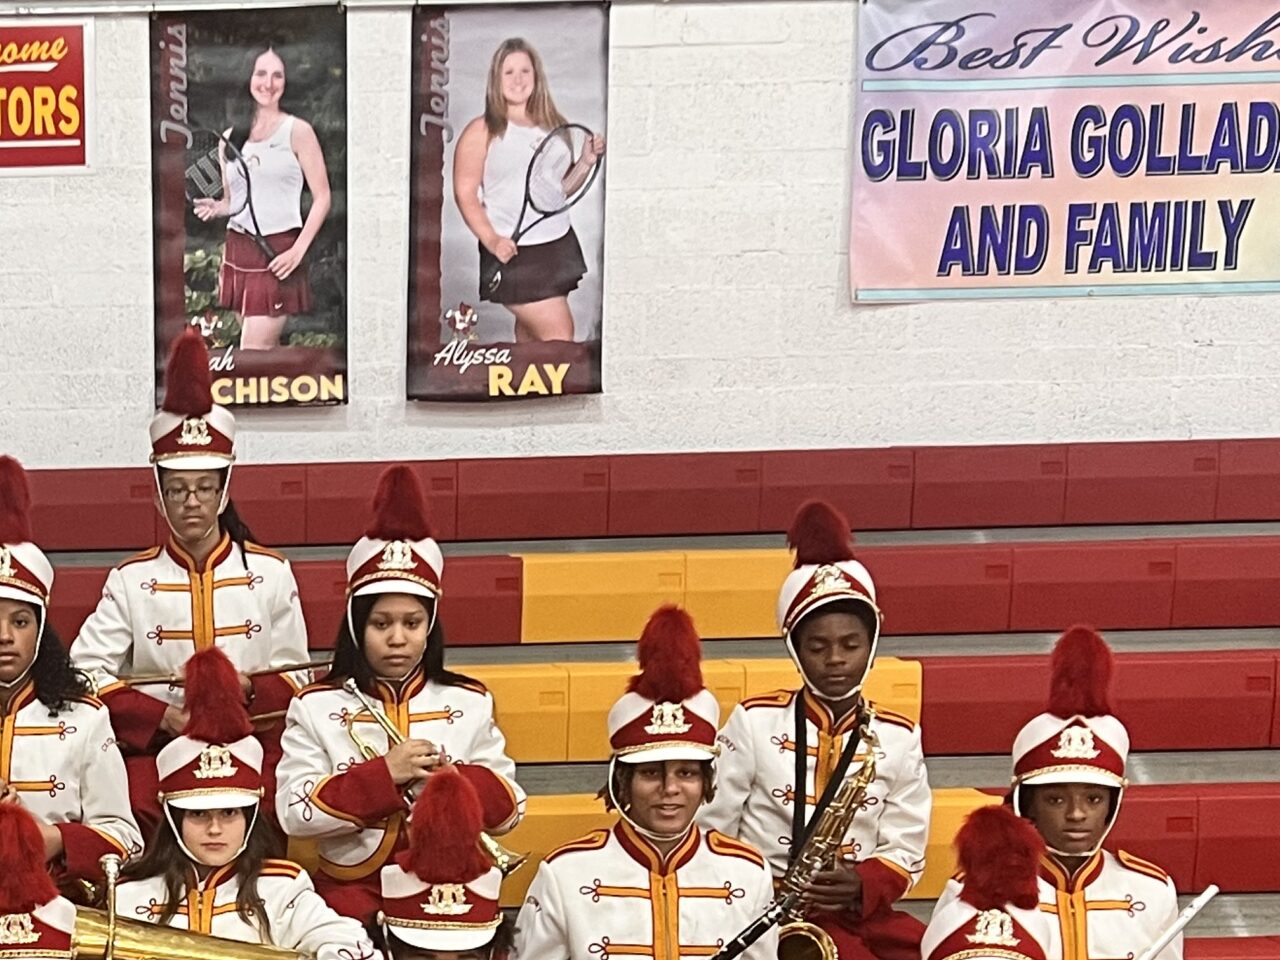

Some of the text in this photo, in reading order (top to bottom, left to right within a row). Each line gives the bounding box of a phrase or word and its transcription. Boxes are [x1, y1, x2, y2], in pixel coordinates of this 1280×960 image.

[418, 15, 453, 143] Tennis
[865, 11, 1280, 72] Best Wish
[156, 22, 193, 148] Tennis
[861, 101, 1280, 182] GLORIA GOLLAD
[936, 197, 1256, 277] AND FAMILY
[433, 339, 512, 374] Alyssa
[488, 363, 570, 396] RAY
